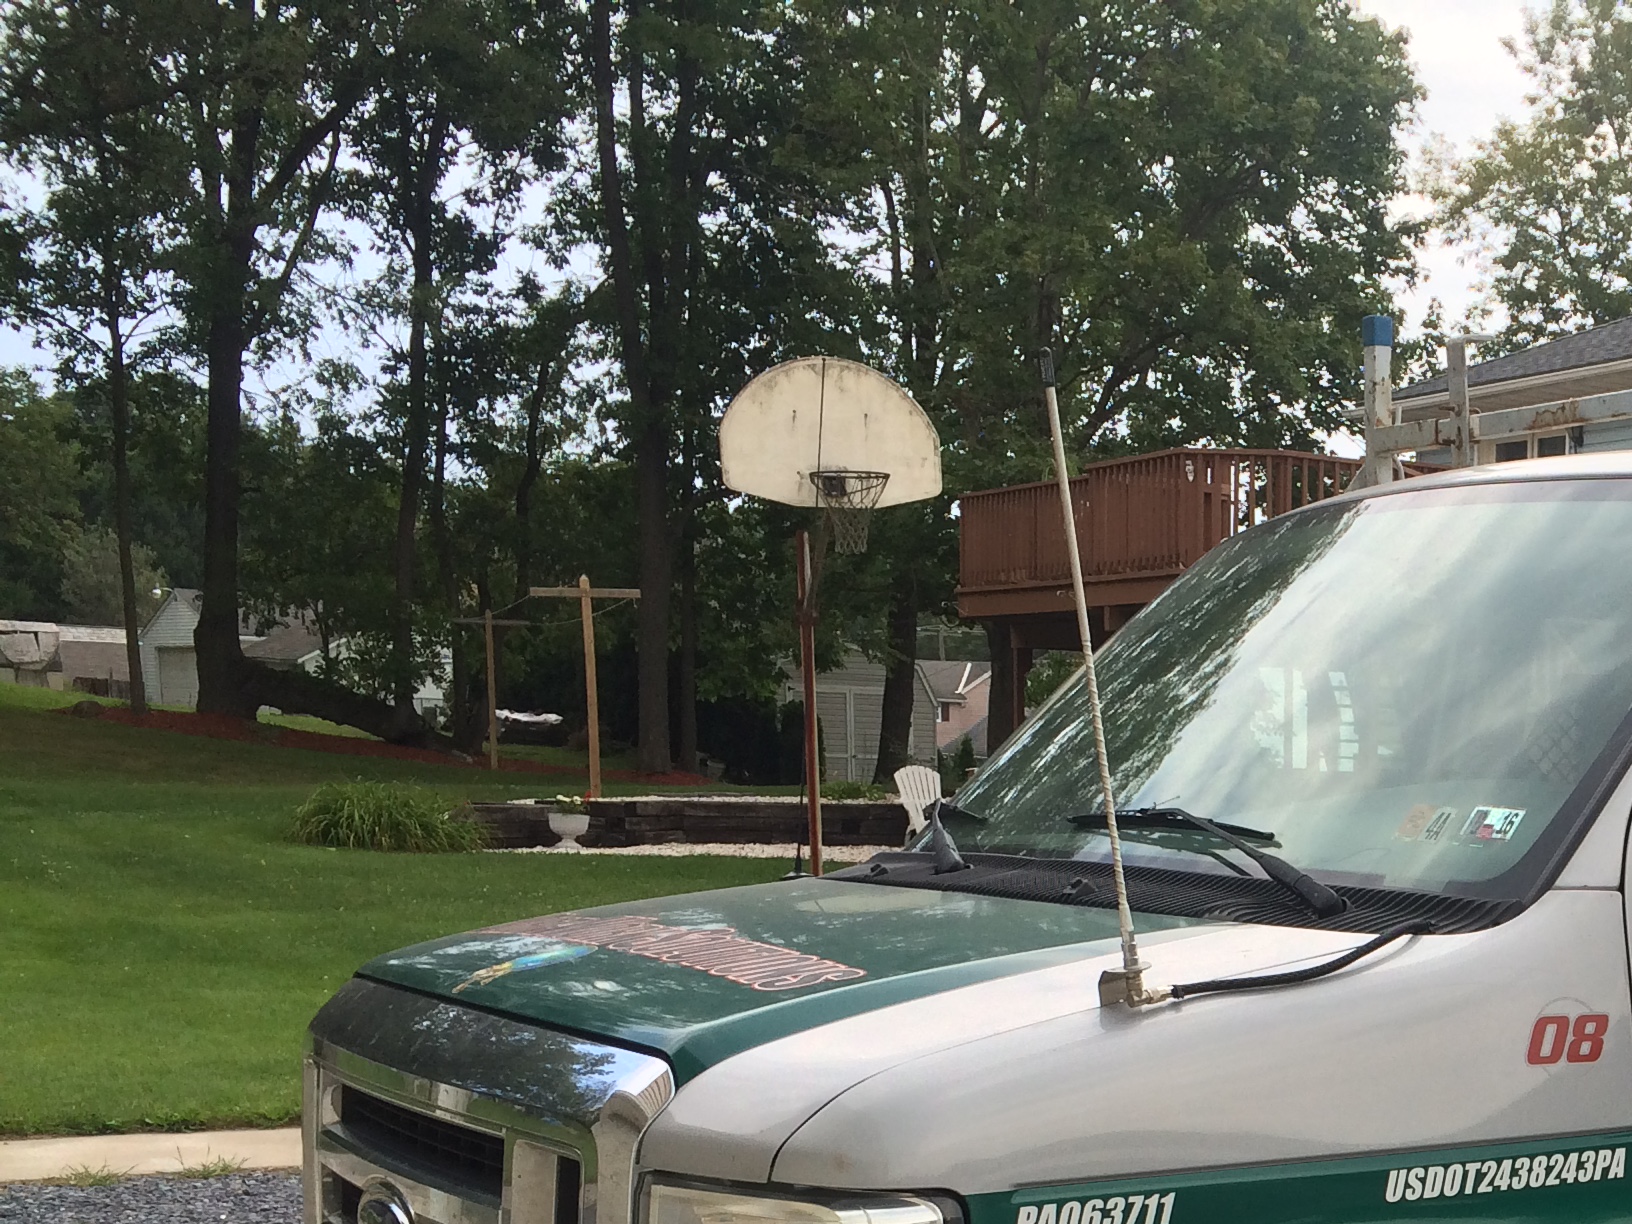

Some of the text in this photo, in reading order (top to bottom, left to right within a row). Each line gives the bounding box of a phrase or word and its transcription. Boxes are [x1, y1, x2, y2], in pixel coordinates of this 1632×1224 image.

[1495, 811, 1519, 835] 16
[1526, 1013, 1609, 1066] 08
[1385, 1148, 1627, 1203] USDOT2438243PA
